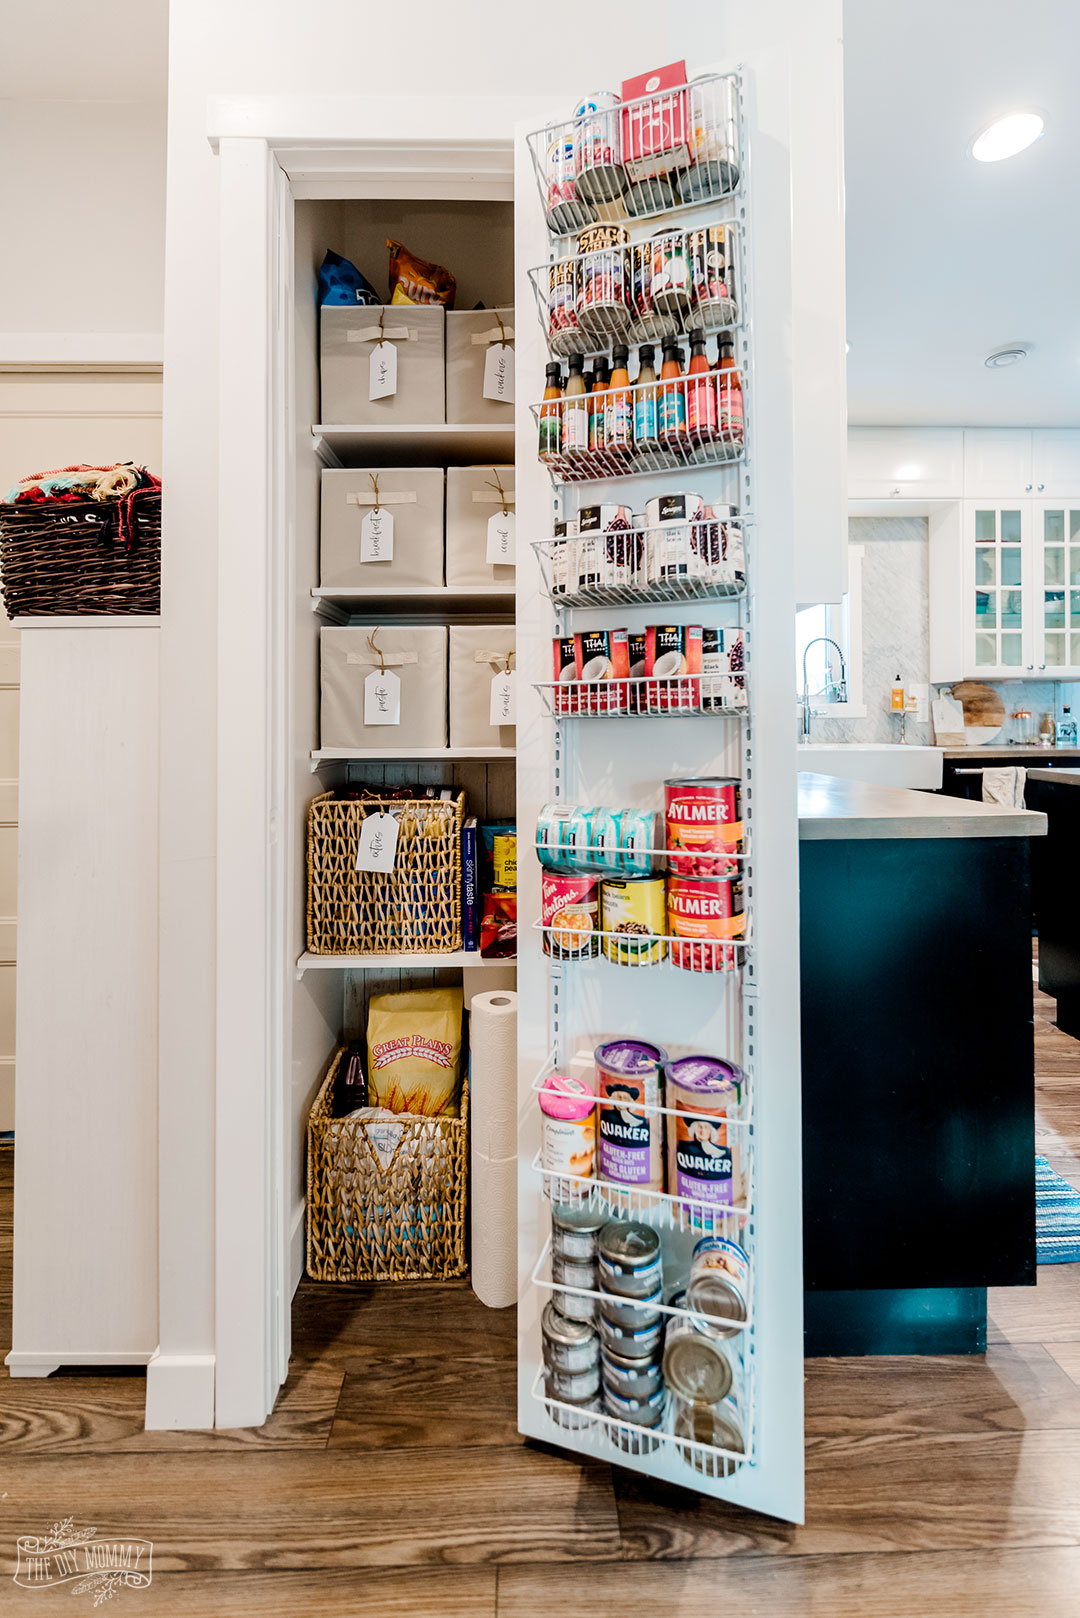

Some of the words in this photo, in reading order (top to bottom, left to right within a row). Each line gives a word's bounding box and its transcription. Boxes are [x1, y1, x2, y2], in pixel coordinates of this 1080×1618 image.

[377, 361, 388, 385] chips
[494, 358, 506, 395] crackers
[370, 513, 382, 557] breakfast
[584, 639, 606, 649] THAI
[658, 632, 682, 643] THAI
[500, 685, 511, 717] snacks
[667, 802, 729, 821] AYLMER
[465, 859, 475, 905] skinnytaste
[543, 880, 557, 900] Tim
[543, 889, 577, 921] Hortons
[667, 892, 723, 916] AYLMER
[372, 1036, 410, 1057] GREAT
[412, 1034, 453, 1055] PLAINS
[600, 1119, 649, 1142] QUAKER
[603, 1142, 646, 1161] GLUTEN-FREE
[677, 1151, 732, 1173] QUAKER
[618, 1164, 646, 1176] GLUTEN
[681, 1175, 729, 1194] GLUTEN-FREE
